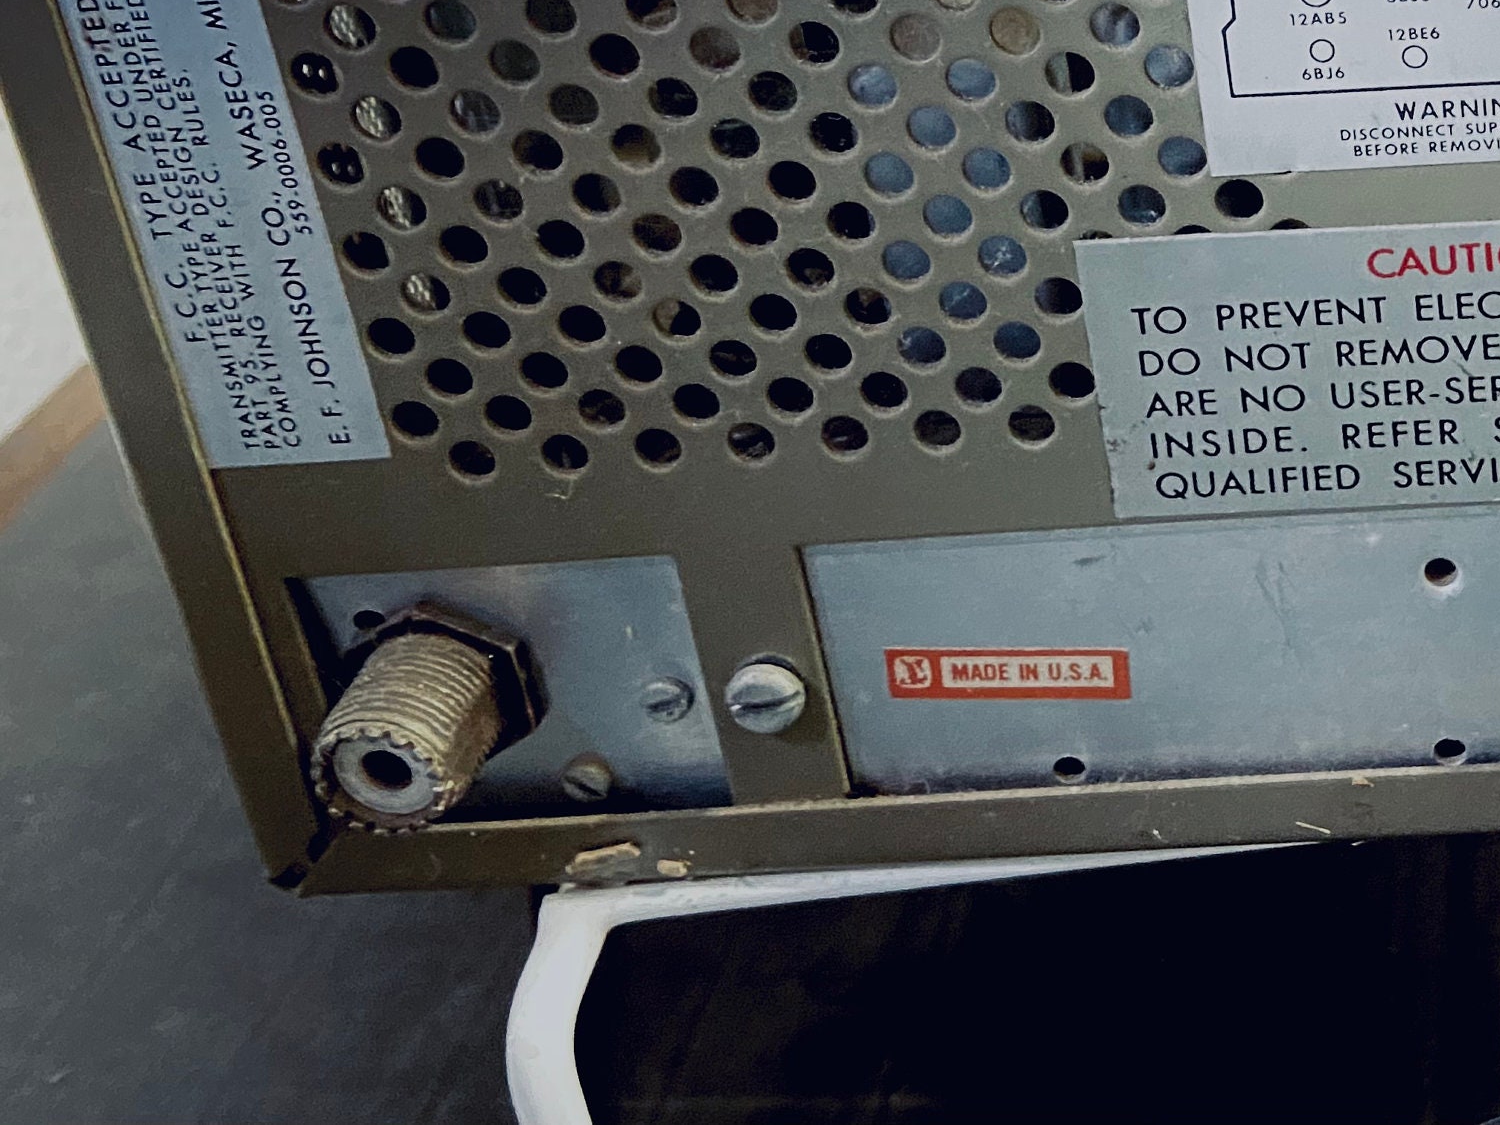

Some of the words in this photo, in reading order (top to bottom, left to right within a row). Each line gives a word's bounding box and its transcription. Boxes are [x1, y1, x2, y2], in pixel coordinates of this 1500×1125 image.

[1290, 11, 1347, 26] 12AB5
[1388, 27, 1440, 41] 12BE6
[114, 22, 153, 102] UNDER
[1302, 67, 1345, 81] 6BJ6
[173, 69, 209, 145] RULES.
[215, 42, 267, 170] WASECA,
[1340, 123, 1455, 141] DISCONNECT
[144, 115, 194, 232] ACCEPTED
[167, 128, 209, 215] DESIGN
[255, 91, 312, 234] 559-0006-005
[1354, 139, 1420, 156] BEFORE
[134, 173, 172, 240] TYPE
[202, 163, 234, 227] F.C.C.
[262, 192, 290, 246] CO.,
[182, 243, 212, 293] TYPE
[201, 233, 247, 336] RECEIVER
[225, 244, 255, 300] WITH
[165, 264, 206, 342] F.C.C.
[276, 258, 335, 388] JOHNSON
[1131, 306, 1187, 336] TO
[1217, 297, 1388, 331] PREVENT
[202, 304, 260, 449] TRANSMITTER
[247, 316, 301, 447] COMPLYING
[1139, 347, 1200, 378] DO
[1225, 342, 1310, 373] NOT
[252, 399, 280, 448] PART
[321, 400, 342, 417] F.
[1146, 390, 1218, 419] ARE
[1241, 384, 1305, 415] NO
[329, 426, 350, 444] E.
[1150, 425, 1307, 460] INSIDE.
[1342, 419, 1458, 450] REFER
[1156, 464, 1360, 501] QUALIFIED
[951, 663, 1007, 681] MADE
[1019, 663, 1037, 681] IN
[1048, 662, 1108, 681] U.S.A.
